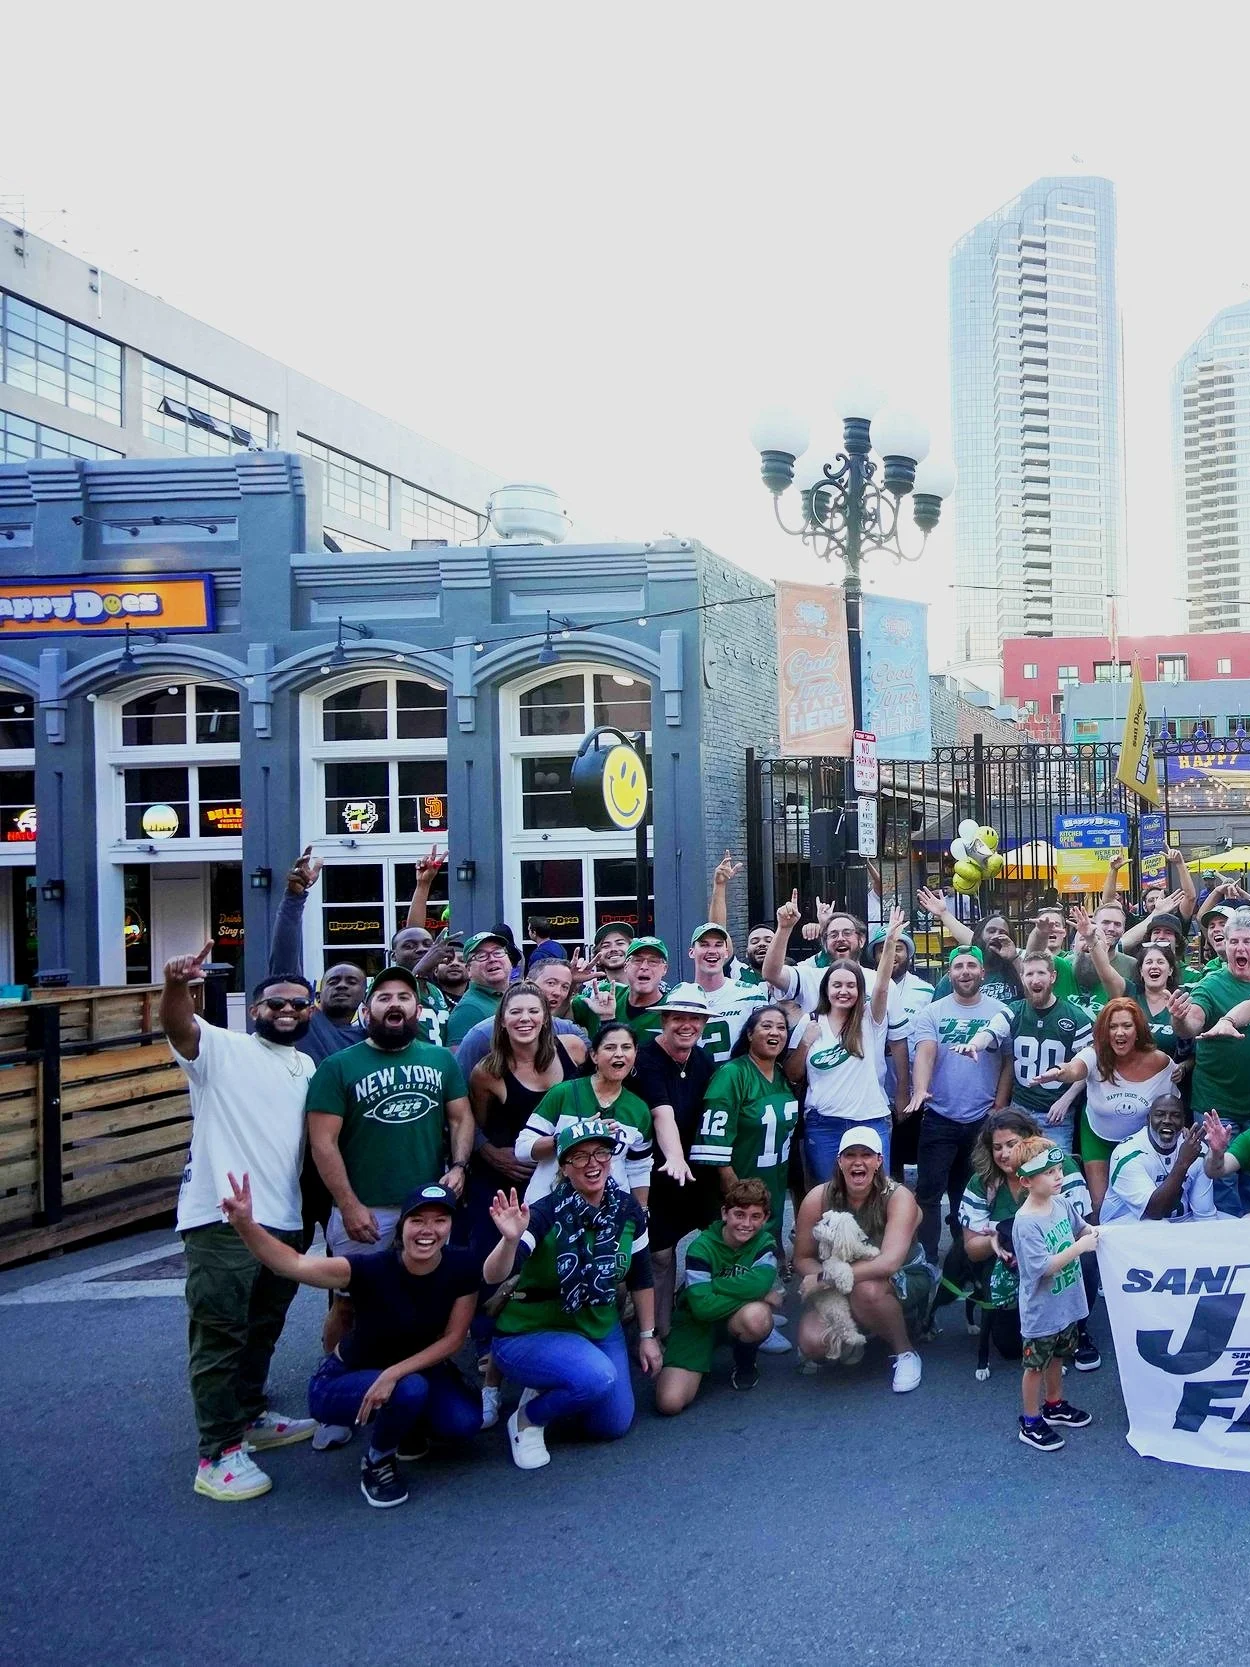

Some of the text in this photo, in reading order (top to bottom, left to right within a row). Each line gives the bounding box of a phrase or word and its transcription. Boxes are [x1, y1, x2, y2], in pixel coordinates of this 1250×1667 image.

[789, 694, 844, 715] START
[872, 701, 922, 720] START
[788, 707, 846, 737] HERE
[871, 714, 925, 737] HERE
[862, 743, 870, 754] NO
[218, 926, 238, 937] Sing
[1013, 1036, 1066, 1090] 80
[355, 1065, 442, 1102] NEW YORK
[393, 1083, 439, 1094] FOOTBALL
[382, 1101, 422, 1115] JETS
[570, 1122, 605, 1139] NYJ
[700, 1109, 729, 1137] 12
[1121, 1266, 1230, 1295] SAN
